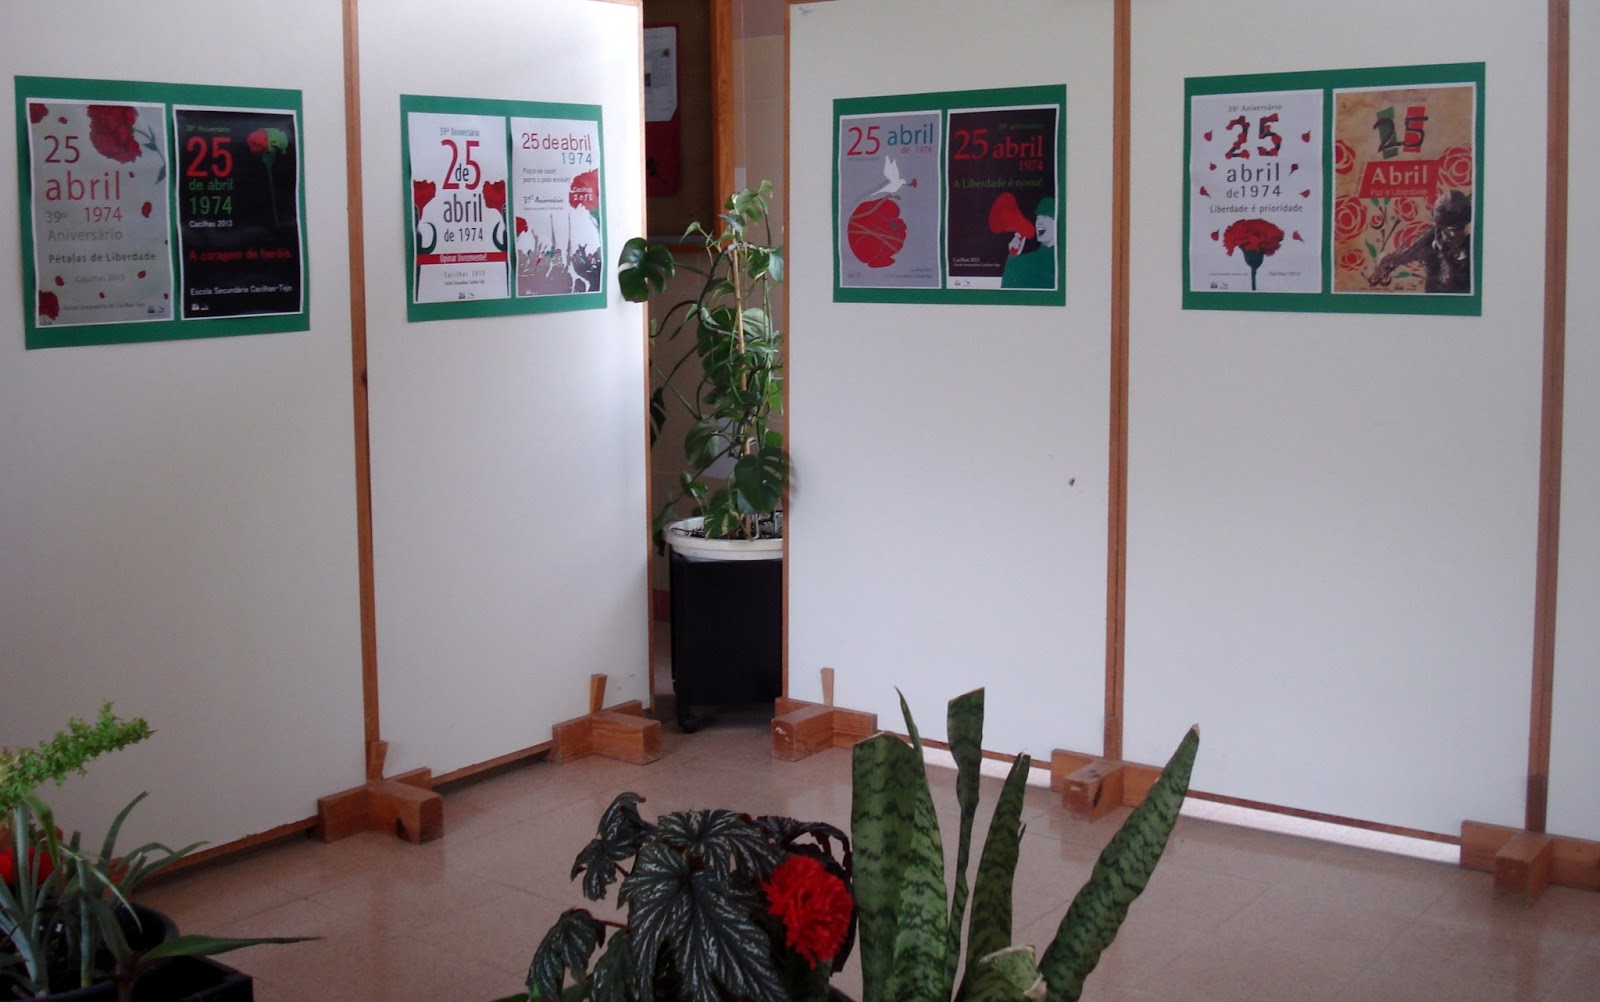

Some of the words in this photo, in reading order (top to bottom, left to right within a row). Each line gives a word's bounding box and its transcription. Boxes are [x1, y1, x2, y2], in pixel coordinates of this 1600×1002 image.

[1241, 103, 1282, 112] Aniversário
[847, 125, 880, 156] 25
[887, 122, 933, 146] abril
[1225, 113, 1282, 159] 25
[1372, 113, 1428, 153] 25
[44, 135, 80, 164] 25
[521, 133, 539, 150] 25
[542, 134, 559, 150] de
[561, 134, 591, 151] abril
[915, 146, 932, 154] 1974
[953, 128, 989, 160] 25
[992, 135, 1043, 159] abril
[186, 136, 233, 178] 25
[441, 139, 481, 190] 25
[561, 152, 592, 165] 1974
[455, 163, 469, 182] de
[1019, 159, 1044, 172] 1974
[1226, 162, 1280, 183] abril
[953, 179, 960, 189] A
[962, 177, 1006, 189] Liberdade
[1007, 176, 1014, 188] é
[1371, 164, 1428, 186] Abril
[45, 170, 120, 201] abril
[188, 179, 203, 191] de
[208, 178, 234, 191] abril
[1370, 188, 1384, 197] Paz
[1392, 188, 1428, 197] Liberdade
[190, 196, 233, 215] 1974
[443, 194, 482, 223] abril
[1210, 204, 1248, 214] Liberdade
[1251, 203, 1256, 213] é
[1259, 203, 1303, 214] prioridade
[84, 206, 122, 222] 1974
[189, 220, 216, 229] Cacilhas
[217, 219, 233, 228] 2013
[47, 228, 123, 242] Aniversário
[444, 230, 455, 242] de
[458, 228, 483, 242] 1974
[90, 252, 103, 262] de
[106, 251, 156, 262] Liberdade
[188, 250, 197, 261] A
[246, 250, 258, 261] de
[190, 288, 212, 297] Escola
[213, 286, 249, 296] Secundária
[250, 284, 293, 295] Cacilhas-Tejo
